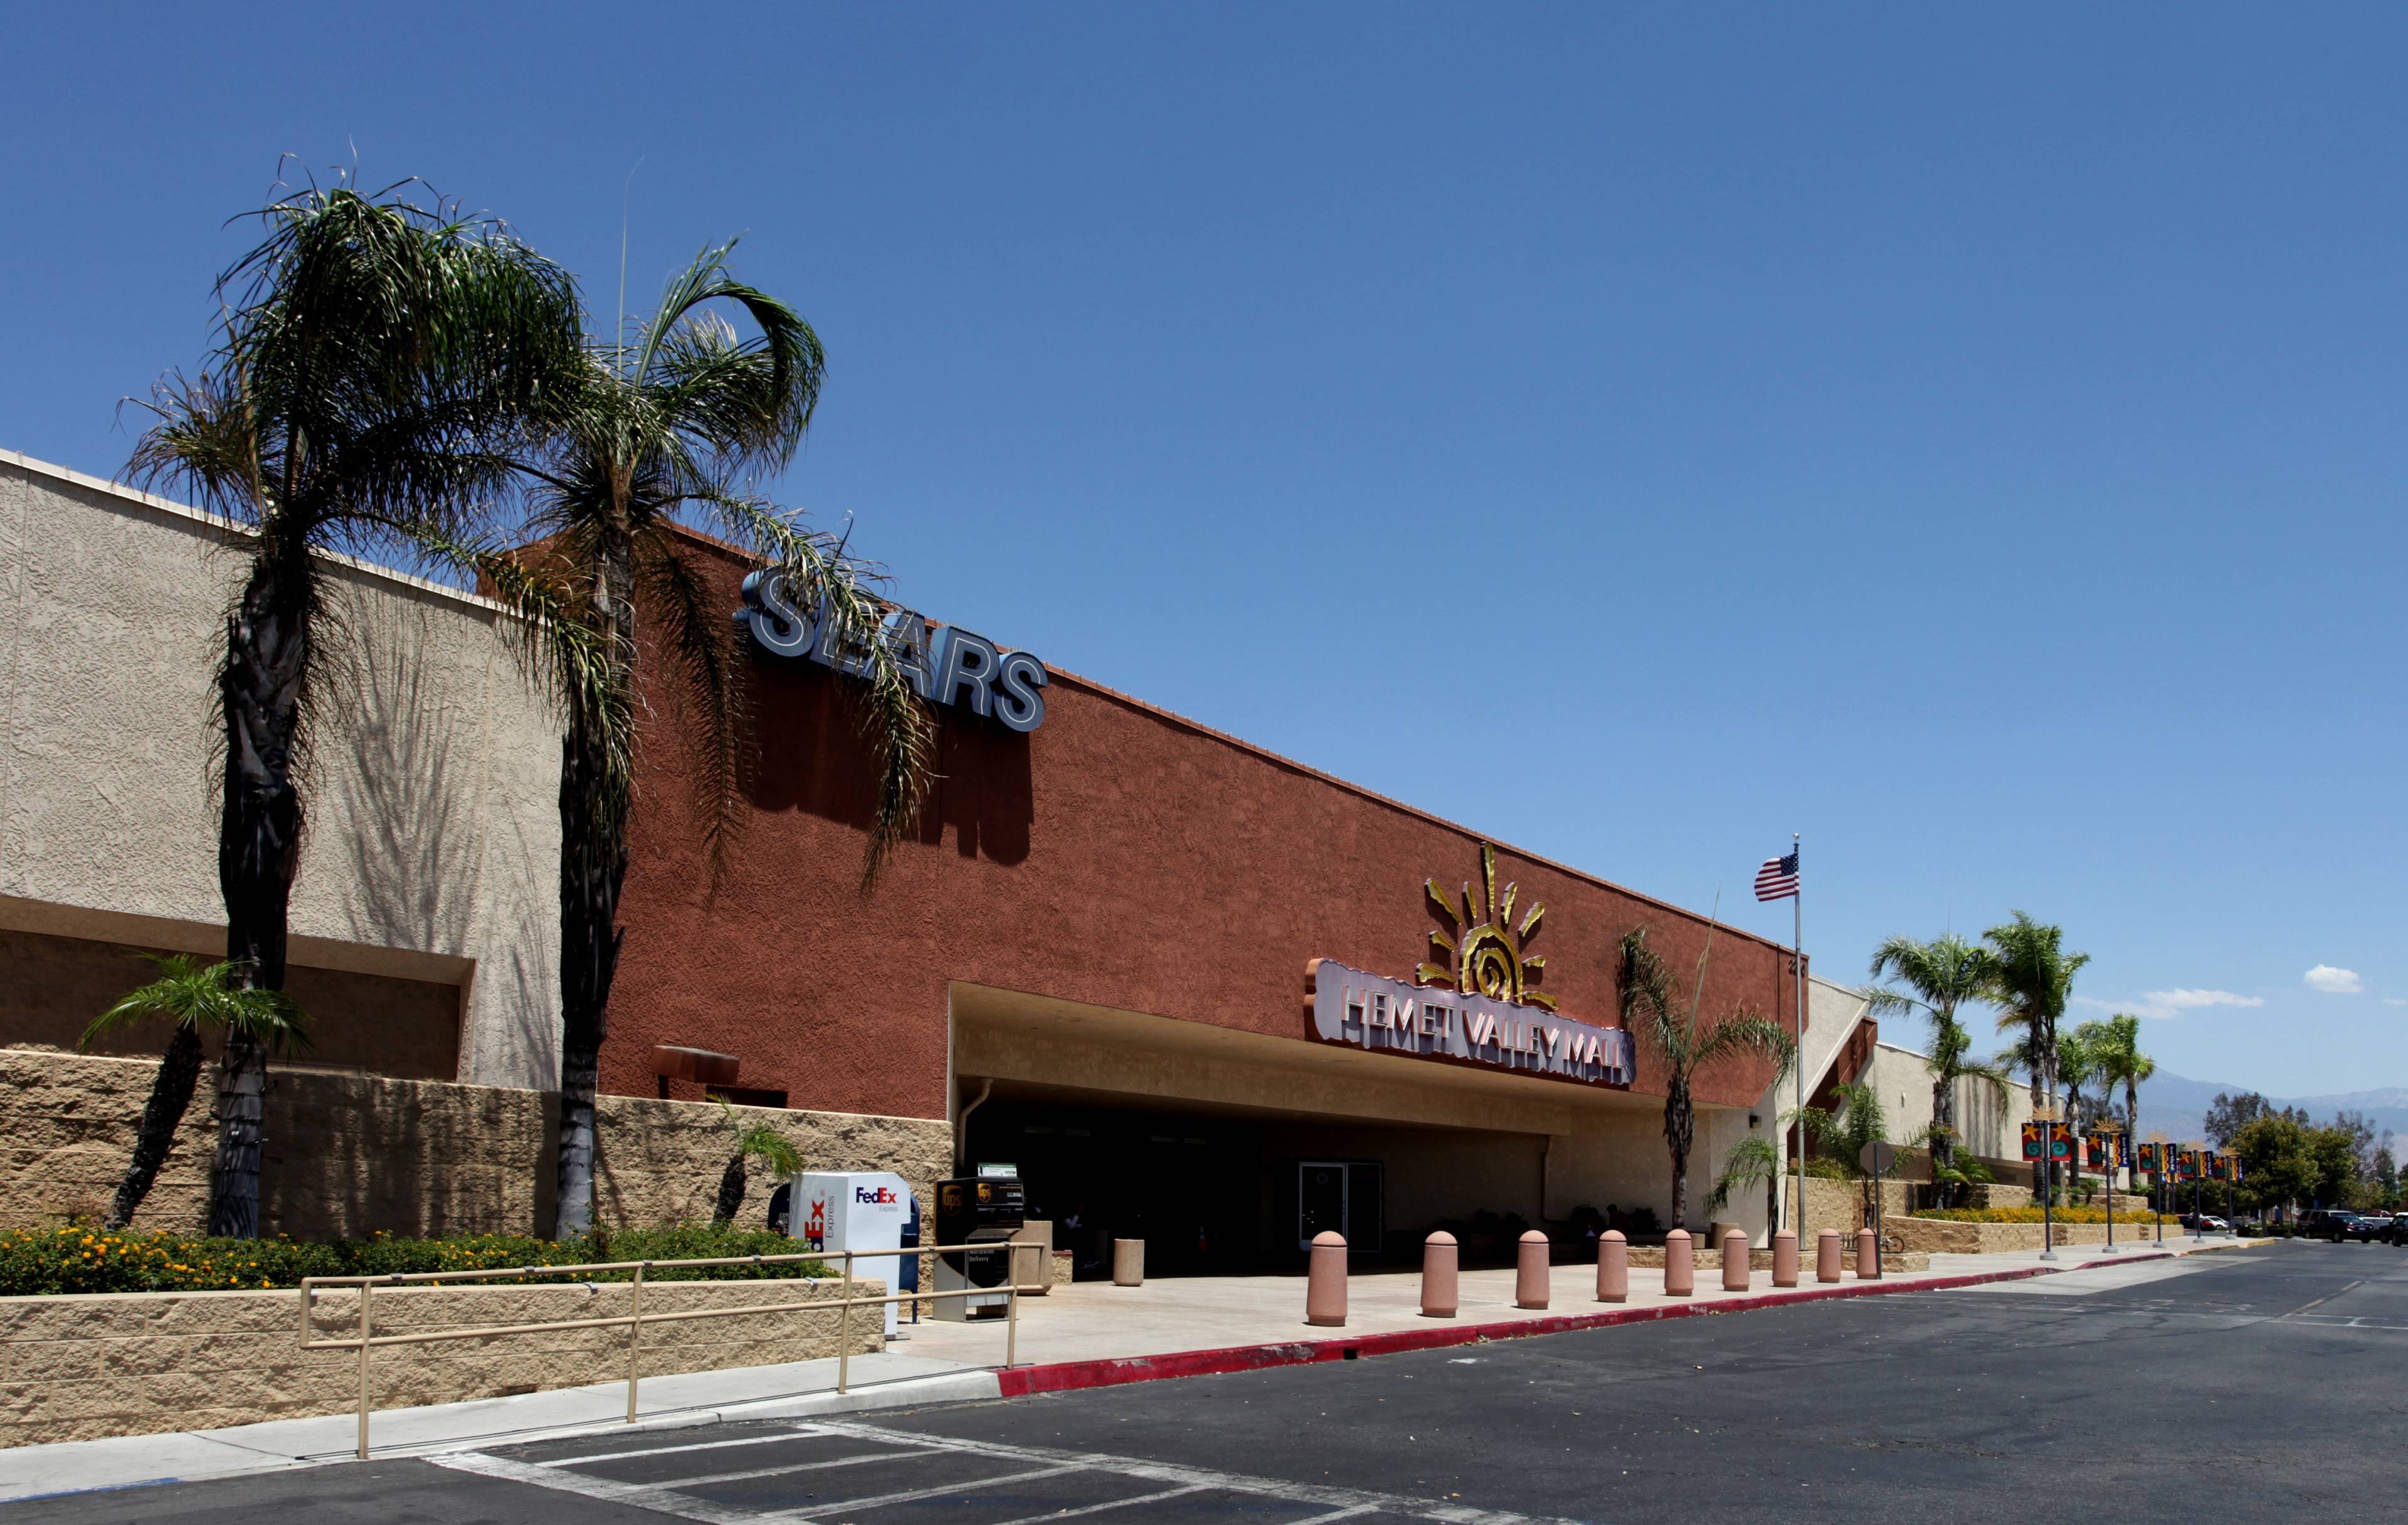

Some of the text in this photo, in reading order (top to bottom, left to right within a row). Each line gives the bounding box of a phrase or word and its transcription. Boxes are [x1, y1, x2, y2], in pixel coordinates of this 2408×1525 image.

[740, 564, 1048, 732] SEARS
[1341, 984, 1623, 1069] HEMET VALLEY MALL
[856, 1187, 897, 1203] FedEx
[943, 1195, 962, 1211] ups
[979, 1189, 991, 1200] ups
[805, 1199, 825, 1253] dEx
[825, 1196, 835, 1238] Express
